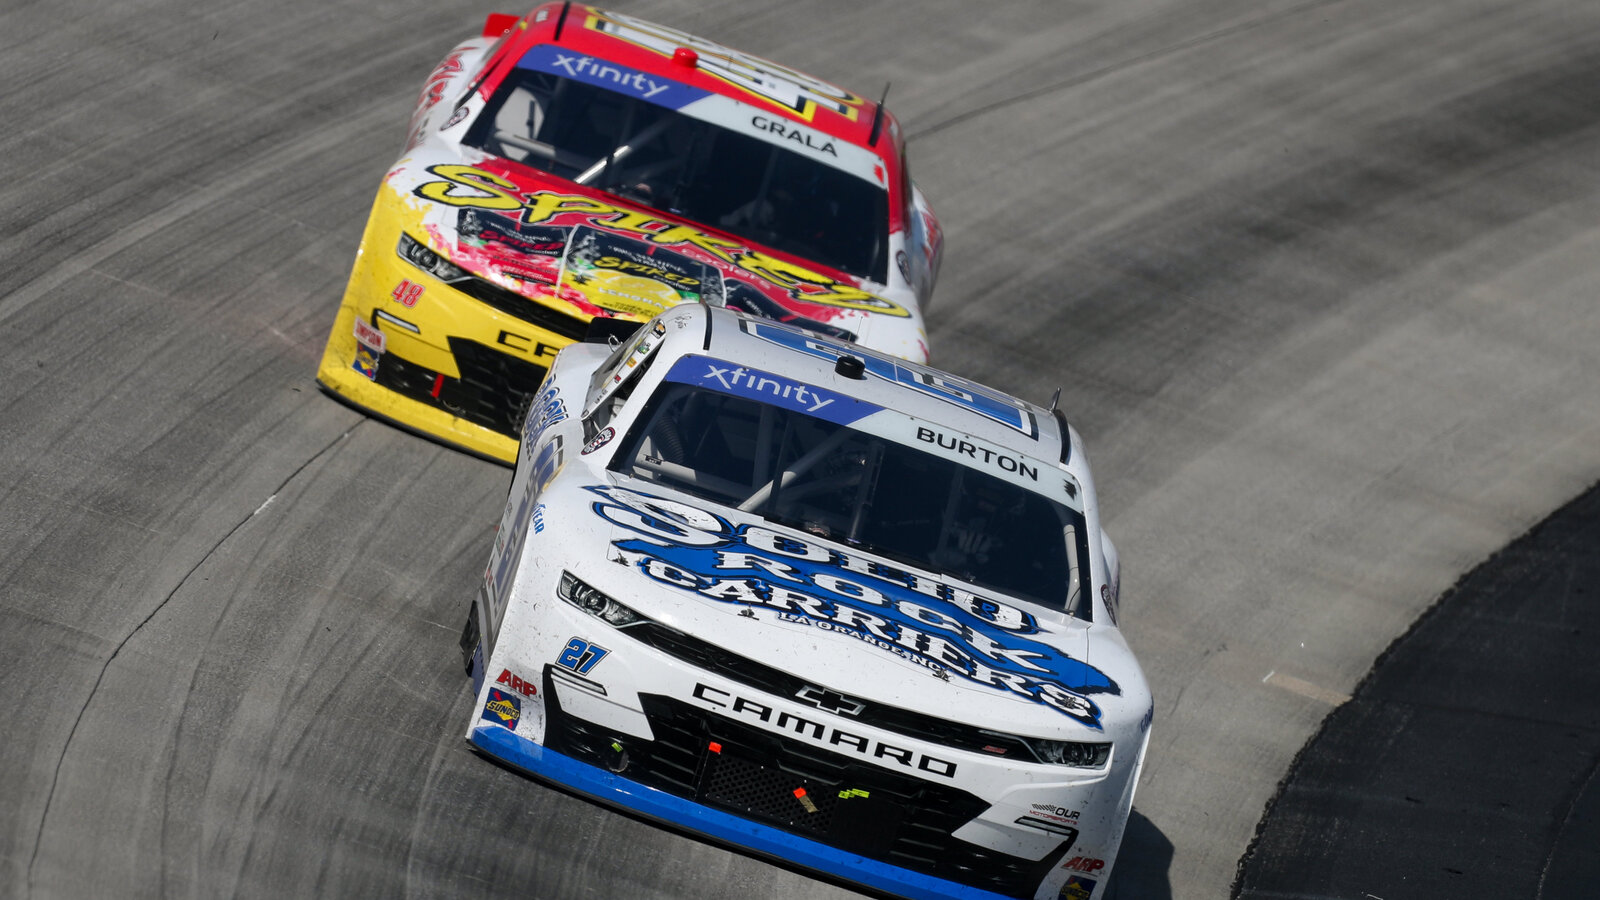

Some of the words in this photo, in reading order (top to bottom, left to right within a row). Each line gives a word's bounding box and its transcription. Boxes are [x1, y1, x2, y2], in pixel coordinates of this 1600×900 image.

[552, 54, 669, 98] xfinity
[751, 115, 838, 158] GRALA
[594, 256, 700, 285] SPIKED
[392, 279, 426, 308] 48
[704, 364, 834, 412] xfinity
[916, 426, 1039, 482] BURTON
[585, 486, 1037, 634] SOLID
[713, 550, 1058, 677] ROCK
[556, 636, 611, 676] 27
[640, 556, 1104, 732] CARRIERS
[778, 611, 811, 626] LA
[910, 652, 944, 673] NC
[496, 668, 537, 697] ARP
[487, 701, 520, 720] SUNOCO
[692, 683, 958, 778] CAMARO
[1029, 810, 1078, 825] MOTORSPORTS
[1055, 807, 1080, 819] OUR
[1063, 856, 1105, 873] ARP
